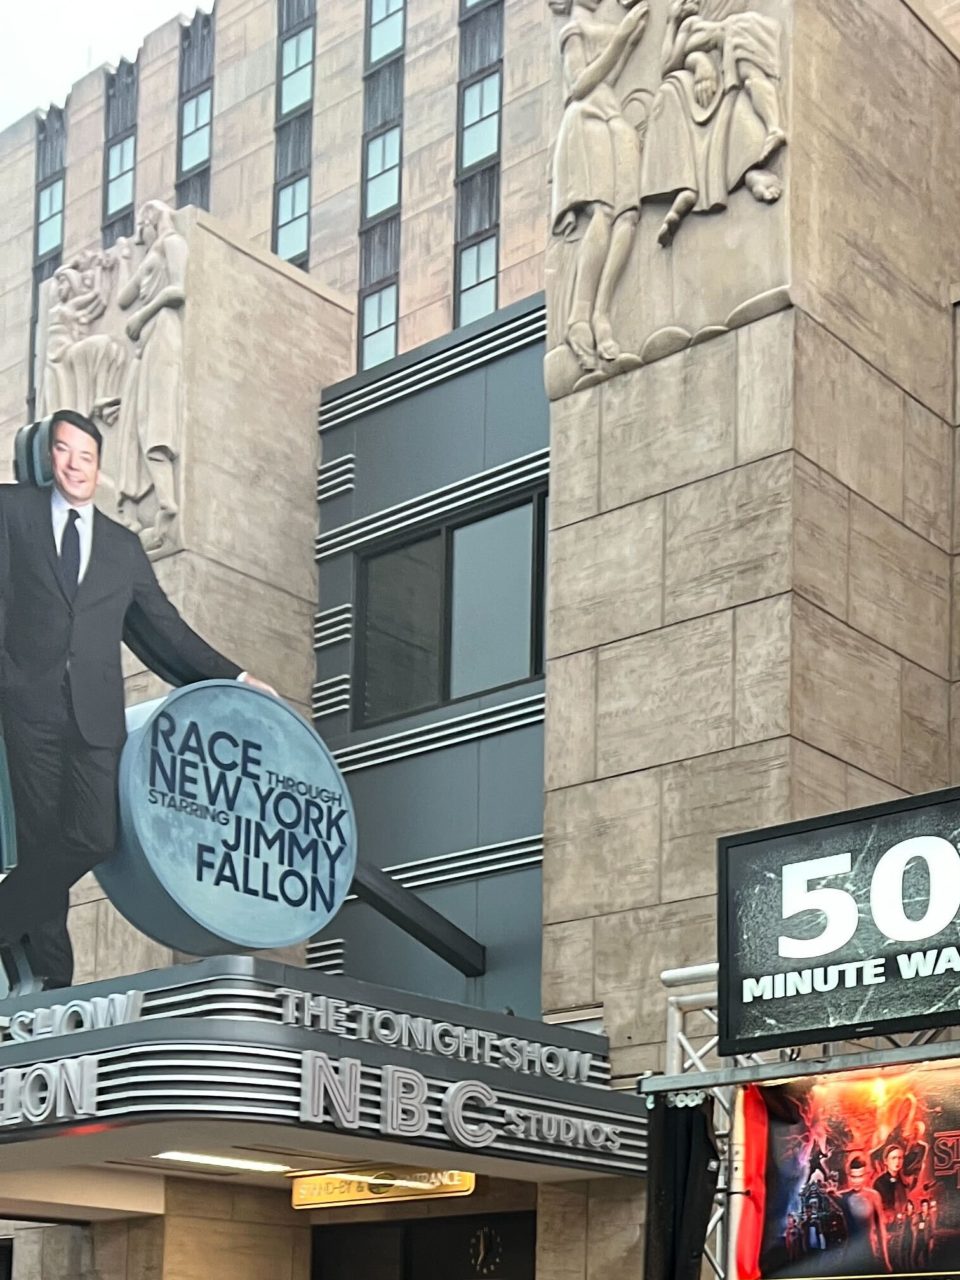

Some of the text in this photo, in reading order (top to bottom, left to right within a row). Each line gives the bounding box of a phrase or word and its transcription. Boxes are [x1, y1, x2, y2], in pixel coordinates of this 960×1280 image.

[149, 749, 349, 846] NEW YORK
[152, 711, 343, 807] RACE THROUGH
[148, 788, 345, 880] STARRING JIMMY
[196, 843, 336, 914] FALLON
[11, 989, 145, 1042] SHOW
[742, 957, 886, 1003] MINUTE
[274, 987, 594, 1083] THE TONIGHT SHOW
[0, 1054, 99, 1122] LON
[300, 1049, 622, 1150] NBC STUDIOS
